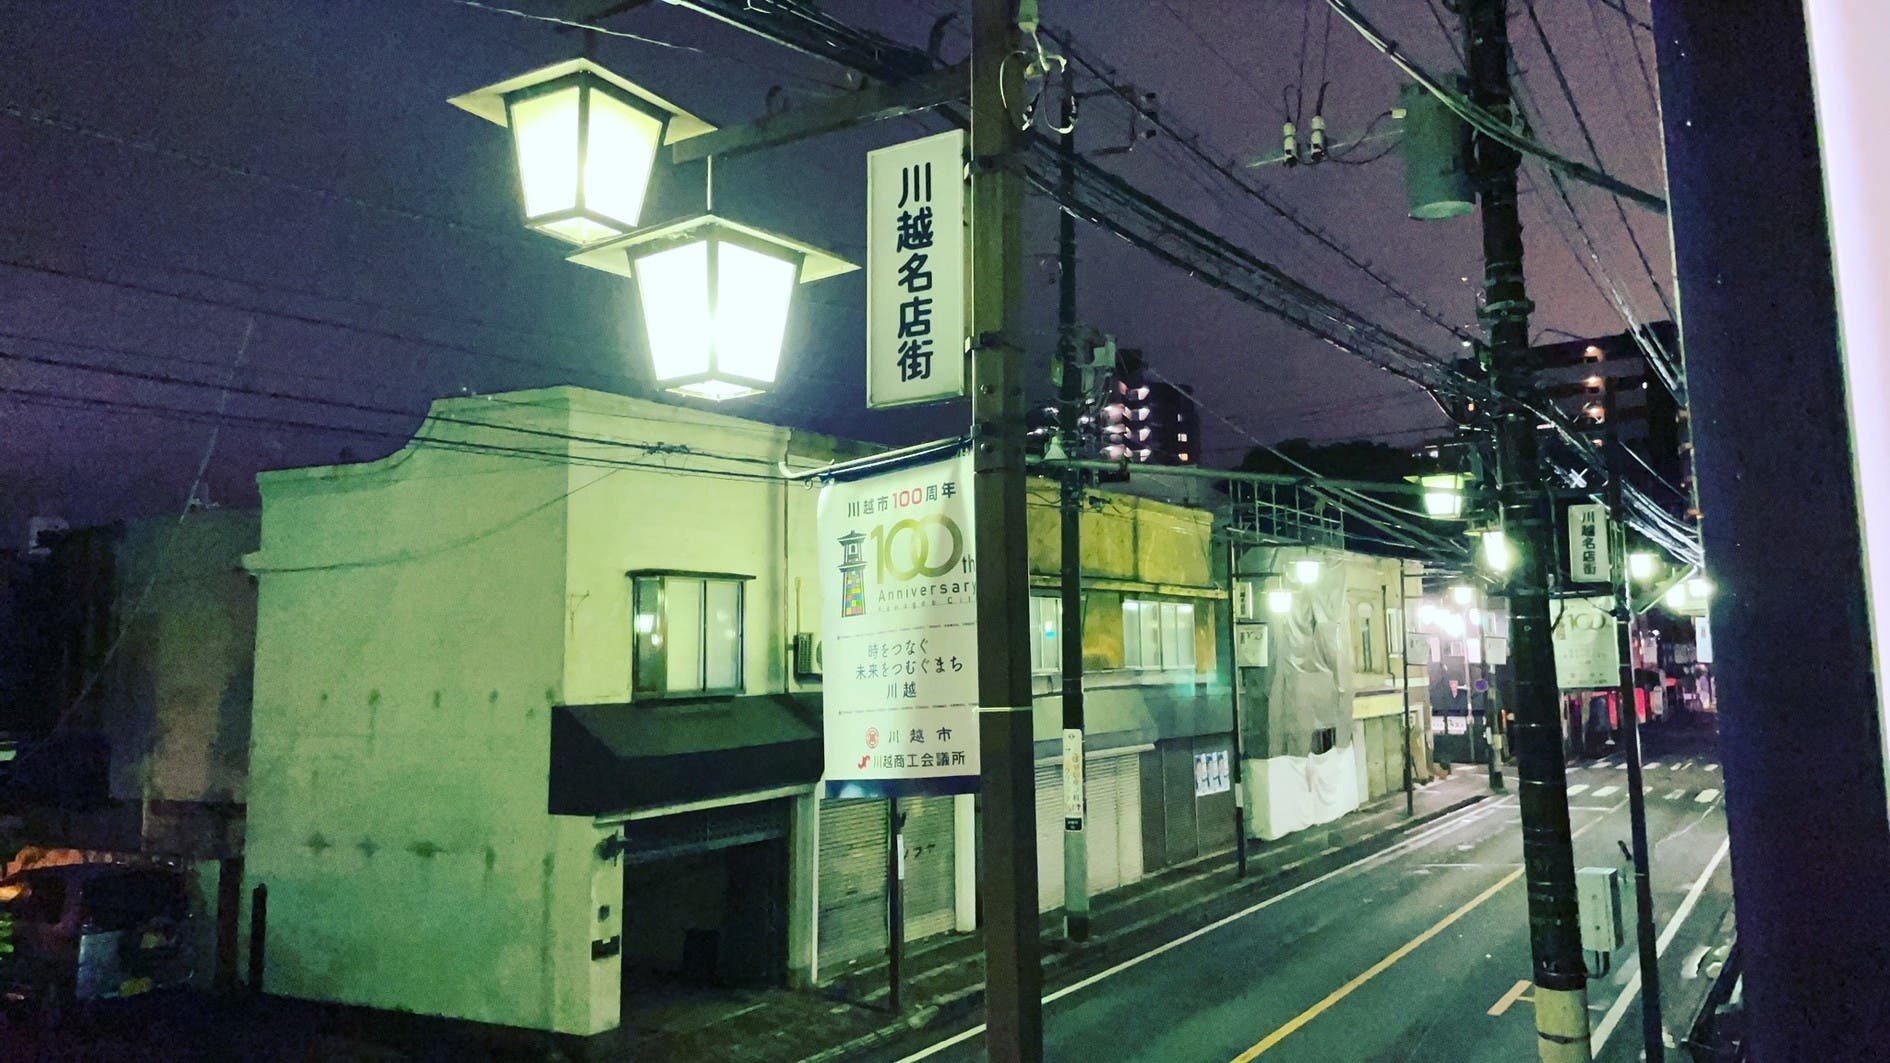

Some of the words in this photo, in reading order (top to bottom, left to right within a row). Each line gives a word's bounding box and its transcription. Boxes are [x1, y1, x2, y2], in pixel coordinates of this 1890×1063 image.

[896, 161, 934, 383] 川越名店街
[847, 481, 957, 518] 川越市100周年
[868, 637, 929, 660] 時をつなぐ
[855, 655, 964, 681] 未来をつむぐまち
[886, 680, 918, 699] 川越
[873, 750, 966, 770] 川越商工会議所
